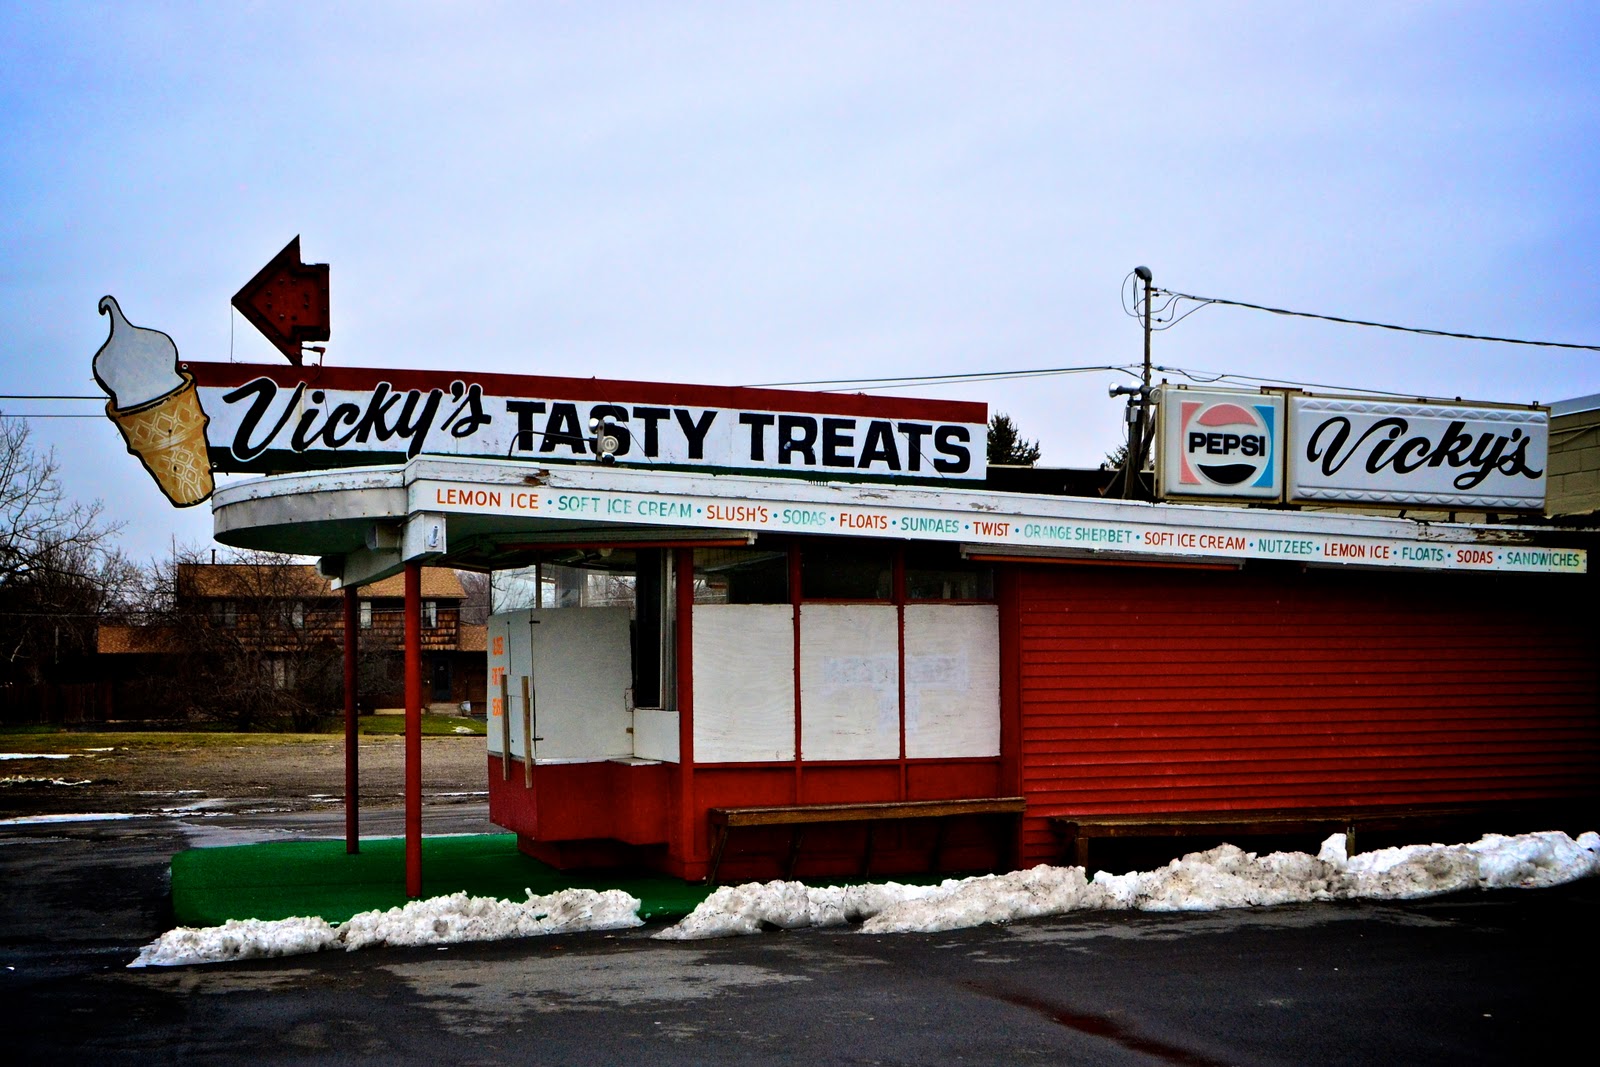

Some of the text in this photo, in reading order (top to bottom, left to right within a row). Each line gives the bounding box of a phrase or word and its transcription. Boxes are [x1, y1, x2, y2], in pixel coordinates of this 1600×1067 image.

[222, 376, 972, 474] Vicky's TASTY TREATS
[1189, 432, 1266, 457] PEPSI
[1306, 415, 1543, 491] Vicky's
[437, 488, 1580, 568] LEMON ICE SOFT ICE CREAM SLUSH'S SODAS FLOATS SUNDAES TWIST ORANGE SHERBET SOFT ICE CREAM NUTZEES LEMON ICE FLOATS SODAS SANDWICHES
